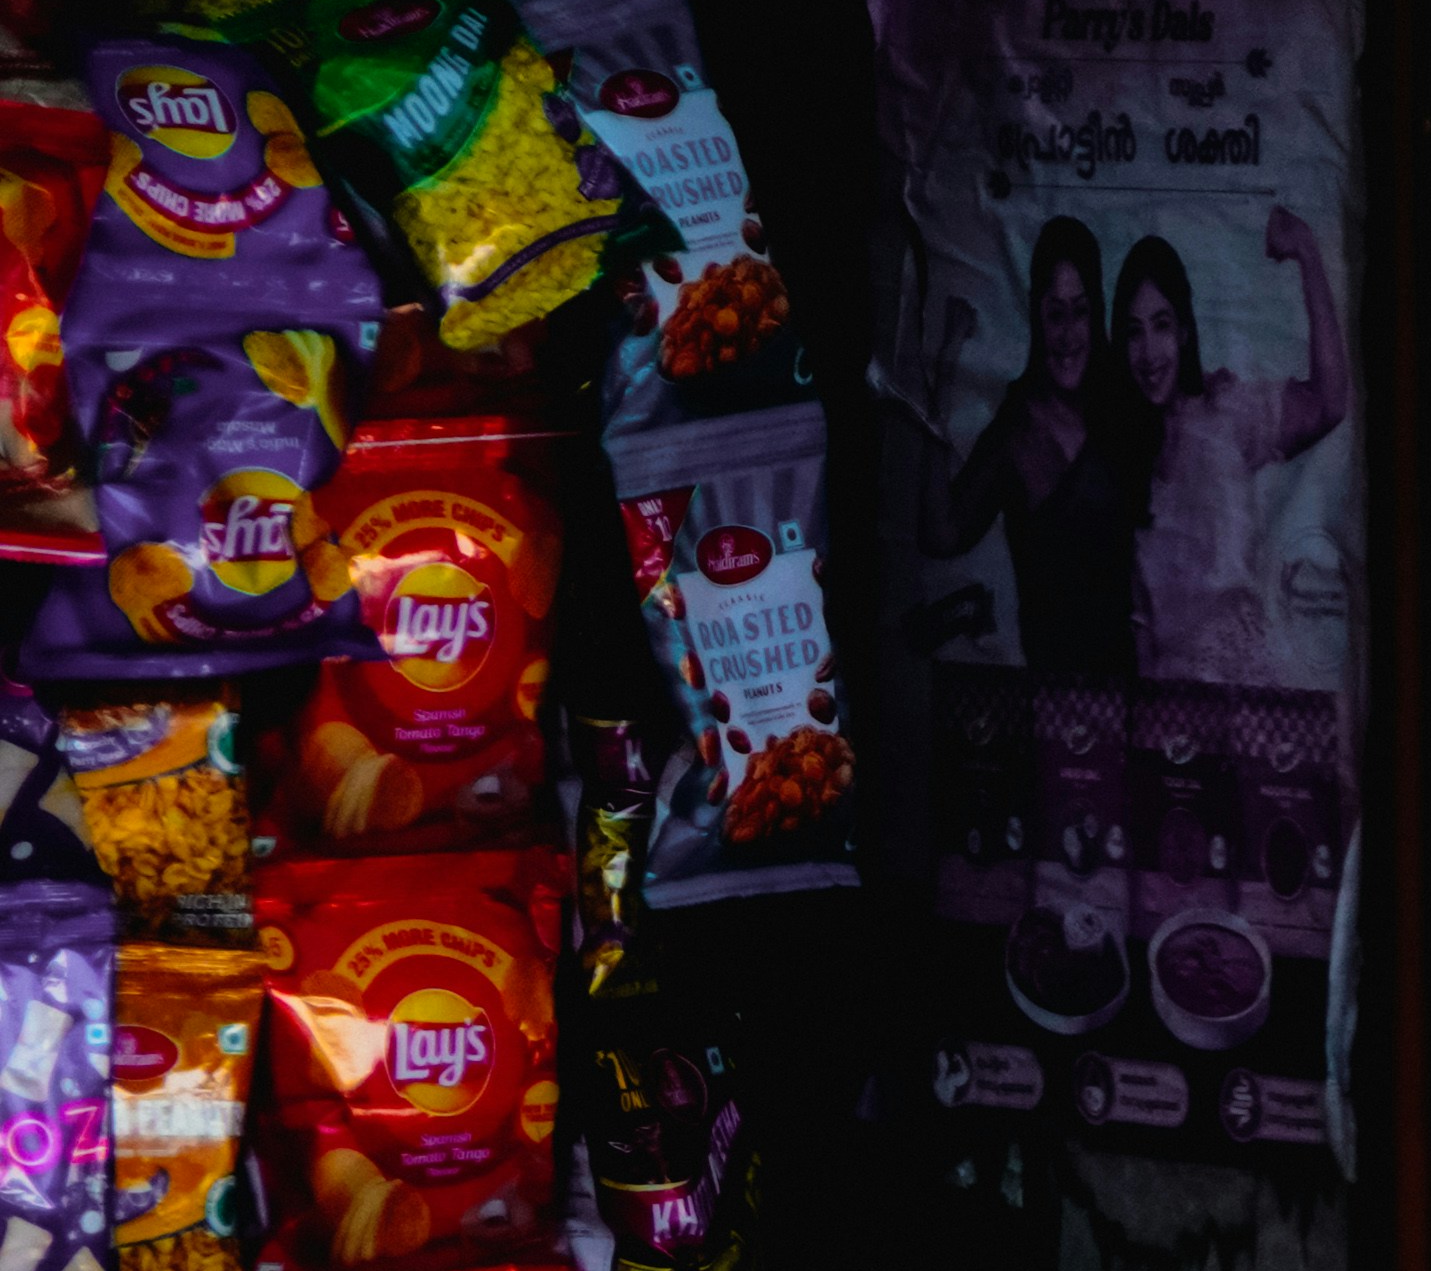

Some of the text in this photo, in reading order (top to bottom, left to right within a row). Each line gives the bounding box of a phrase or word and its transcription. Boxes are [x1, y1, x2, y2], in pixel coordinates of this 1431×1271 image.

[130, 82, 229, 134] Lay's
[381, 46, 472, 149] MOONG
[1164, 113, 1261, 166] ശക്തി
[129, 170, 191, 218] CHIPS
[650, 170, 743, 216] RUSHED
[678, 211, 721, 228] PEANUTS
[354, 498, 507, 549] 25% MORE CHIPS
[393, 593, 491, 664] Lay's
[699, 601, 814, 651] ROASTED
[709, 638, 820, 685] CRUSHED
[743, 681, 783, 701] PEANUTS
[348, 928, 496, 978] 25% MORE CHIPS
[394, 1021, 488, 1088] Lay's
[0, 1095, 109, 1168] OZ
